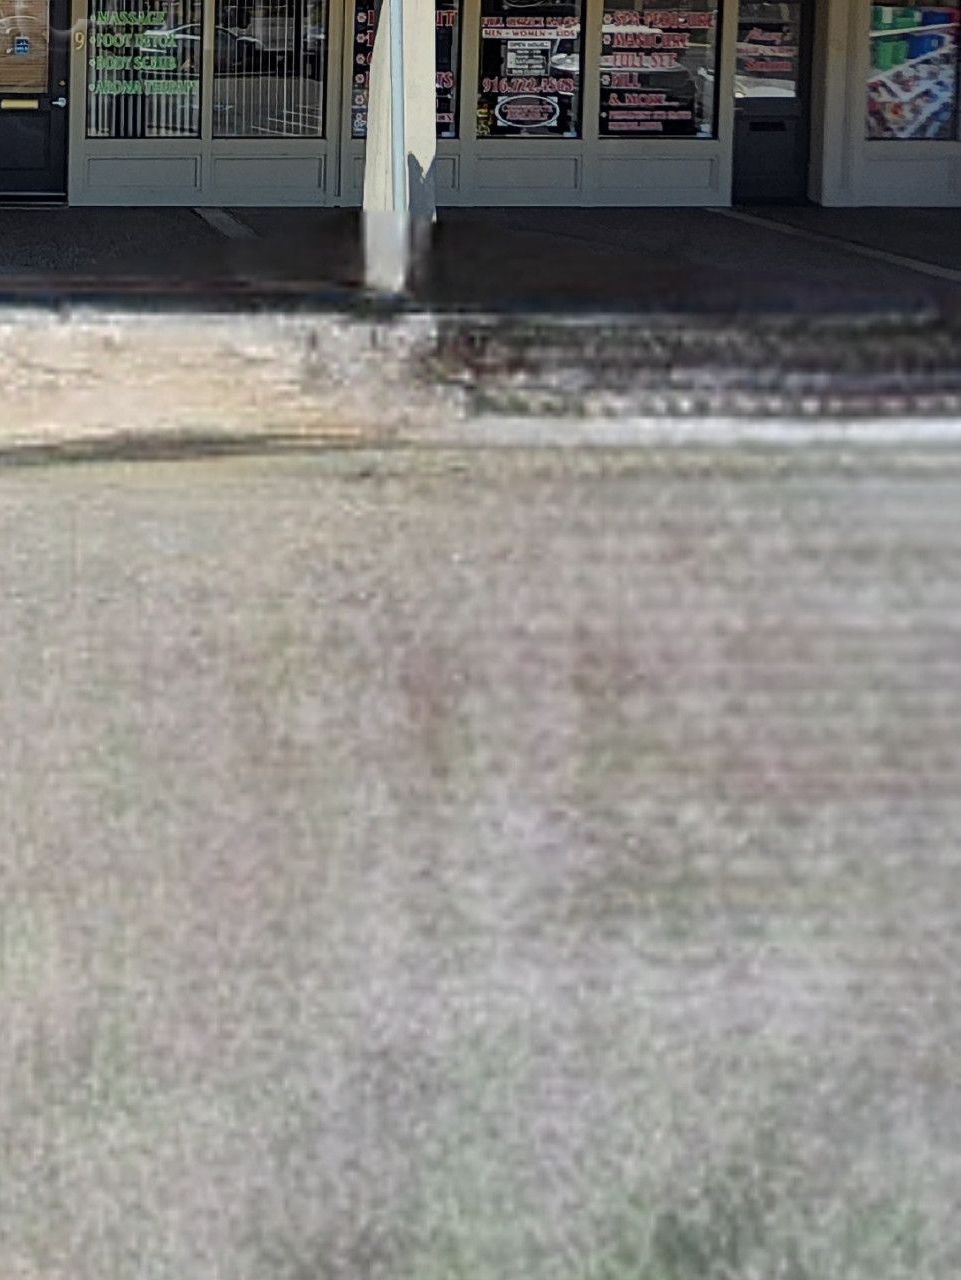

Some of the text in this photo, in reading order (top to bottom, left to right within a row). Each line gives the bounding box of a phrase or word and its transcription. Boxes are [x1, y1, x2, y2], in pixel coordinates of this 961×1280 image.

[96, 10, 166, 26] MASSAGE
[613, 9, 714, 29] SPA PEDICURE
[74, 31, 85, 50] 9
[96, 33, 133, 48] FOOT
[483, 29, 576, 37] MEN WOMEN KIDS
[612, 31, 691, 49] MANICURE
[96, 55, 133, 70] BODY
[613, 52, 678, 69] FULL SET
[609, 93, 623, 106] &
